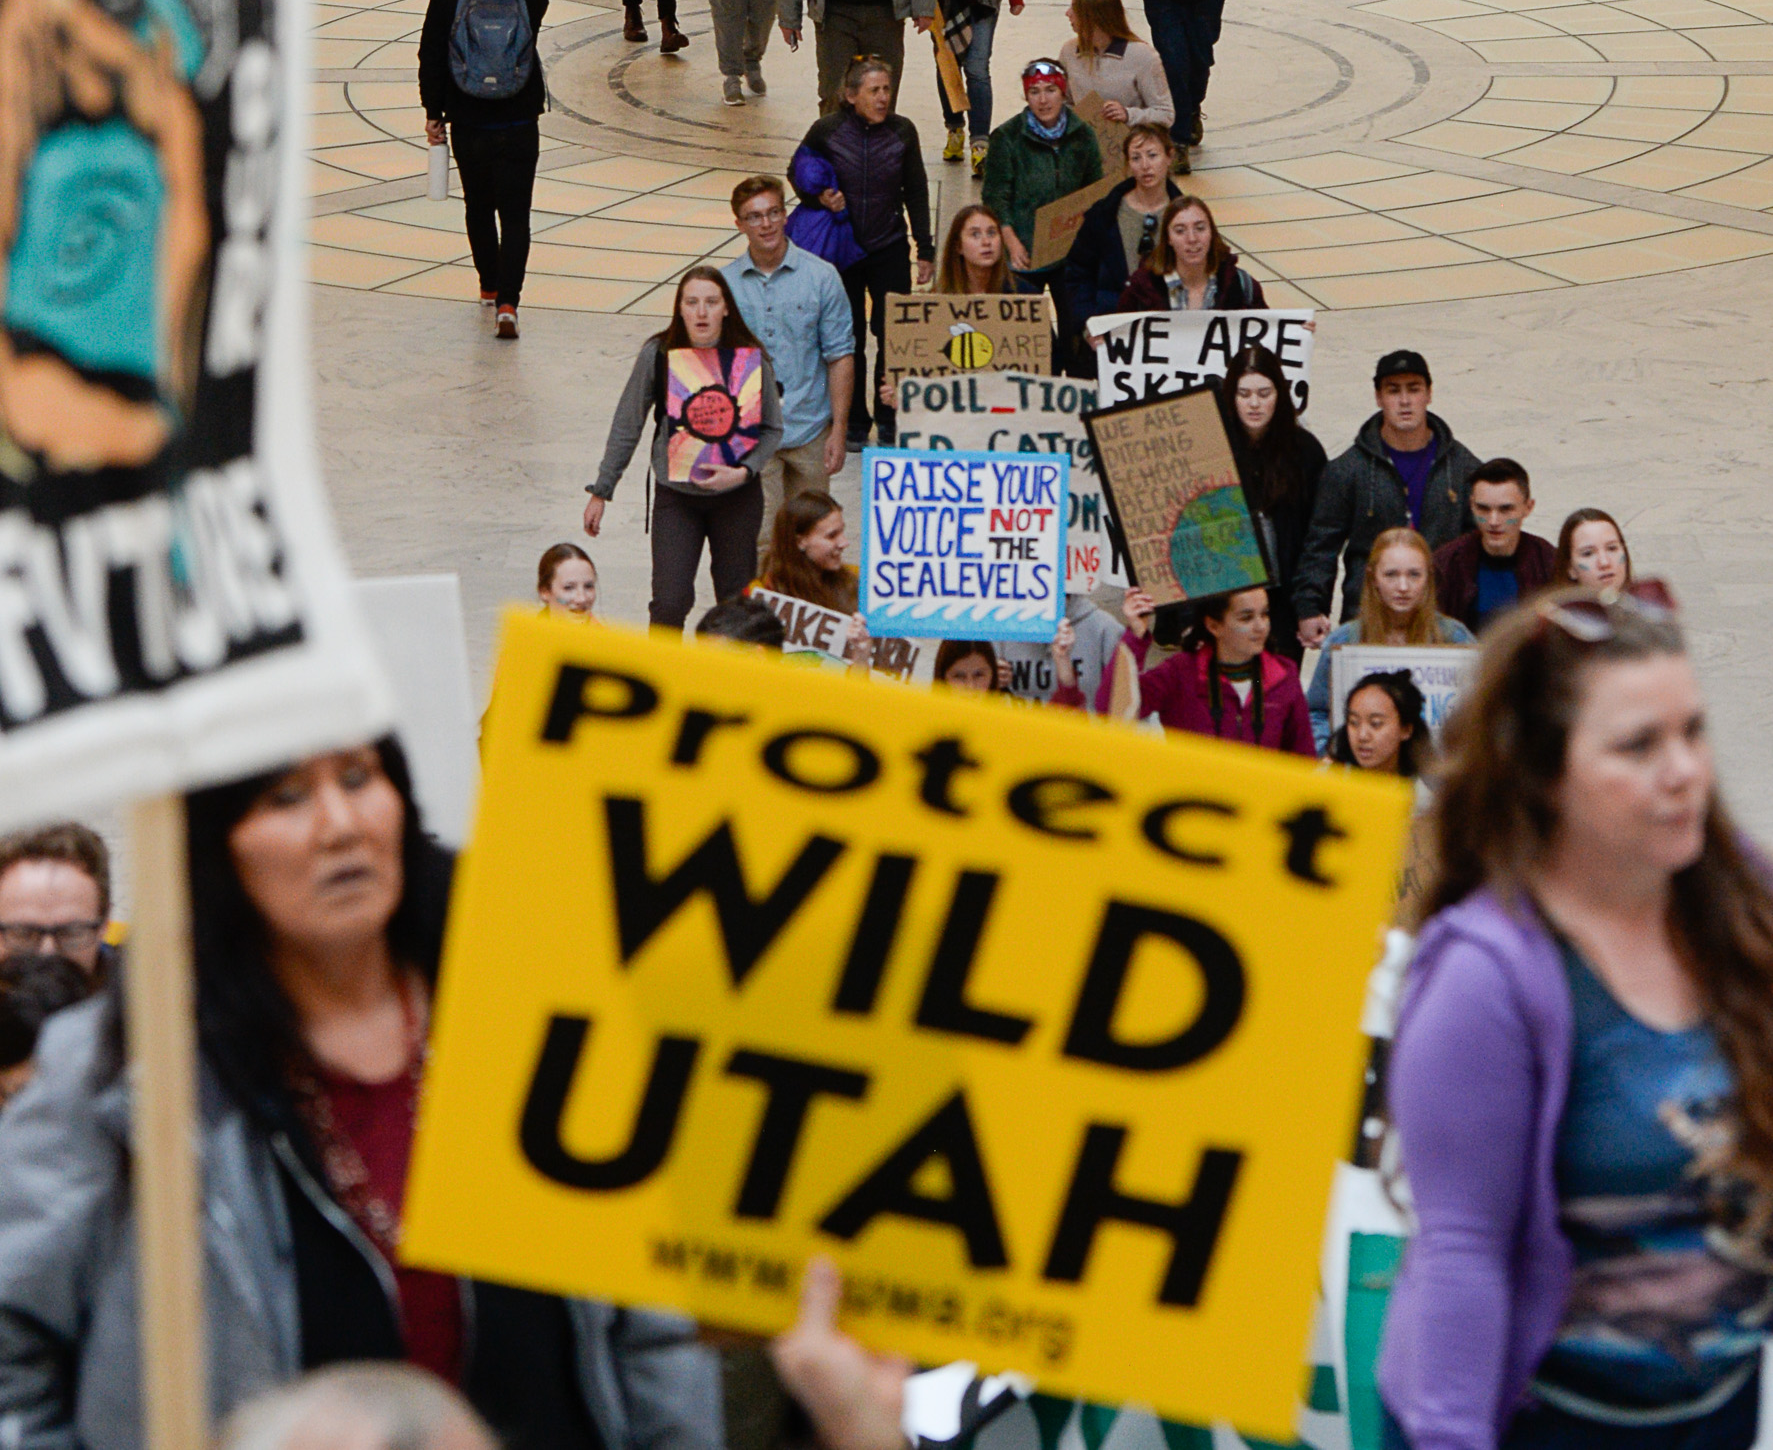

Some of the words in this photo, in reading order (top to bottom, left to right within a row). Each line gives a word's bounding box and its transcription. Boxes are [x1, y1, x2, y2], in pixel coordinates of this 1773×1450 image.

[894, 302, 939, 324] IF
[949, 300, 989, 320] WE
[1000, 300, 1042, 323] DIE
[888, 338, 930, 358] WE
[999, 334, 1048, 358] ARE
[1104, 316, 1172, 366] WE
[1197, 316, 1308, 369] ARE
[1096, 417, 1135, 442] WE
[1143, 403, 1190, 435] ARE
[1103, 431, 1193, 469] DITCHING
[873, 460, 986, 503] RAISE
[992, 463, 1058, 505] YOUR
[1110, 457, 1197, 489] SCHOOL
[874, 505, 985, 559] VOICE
[990, 508, 1053, 532] NOT
[989, 537, 1039, 560] THE
[873, 560, 1052, 600] SEALEVELS
[535, 661, 1353, 890] Protect
[600, 793, 1250, 1077] WILD
[513, 1010, 1247, 1311] UTAH
